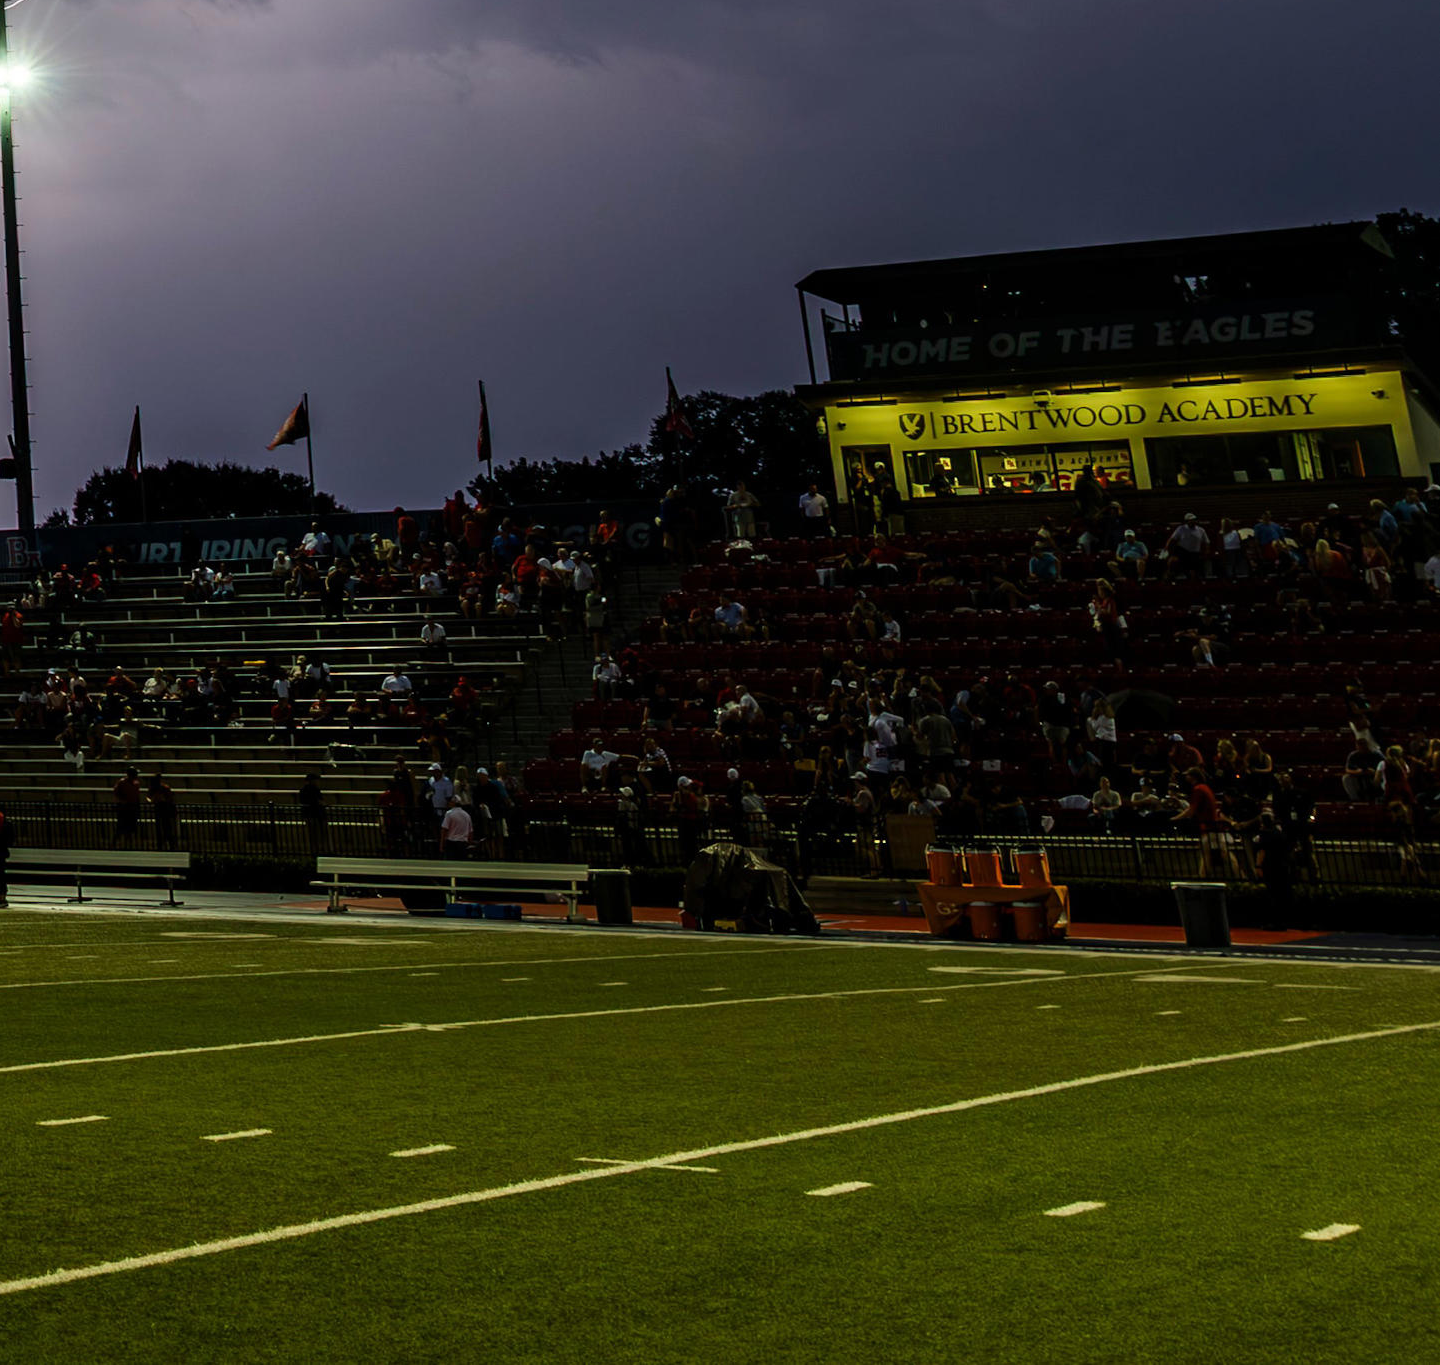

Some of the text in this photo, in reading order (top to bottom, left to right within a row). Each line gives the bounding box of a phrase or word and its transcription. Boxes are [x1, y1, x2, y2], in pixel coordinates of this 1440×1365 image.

[862, 309, 1315, 369] HOME OF THE EAGLES
[943, 393, 1318, 435] BRENTWOOD ACADEMY
